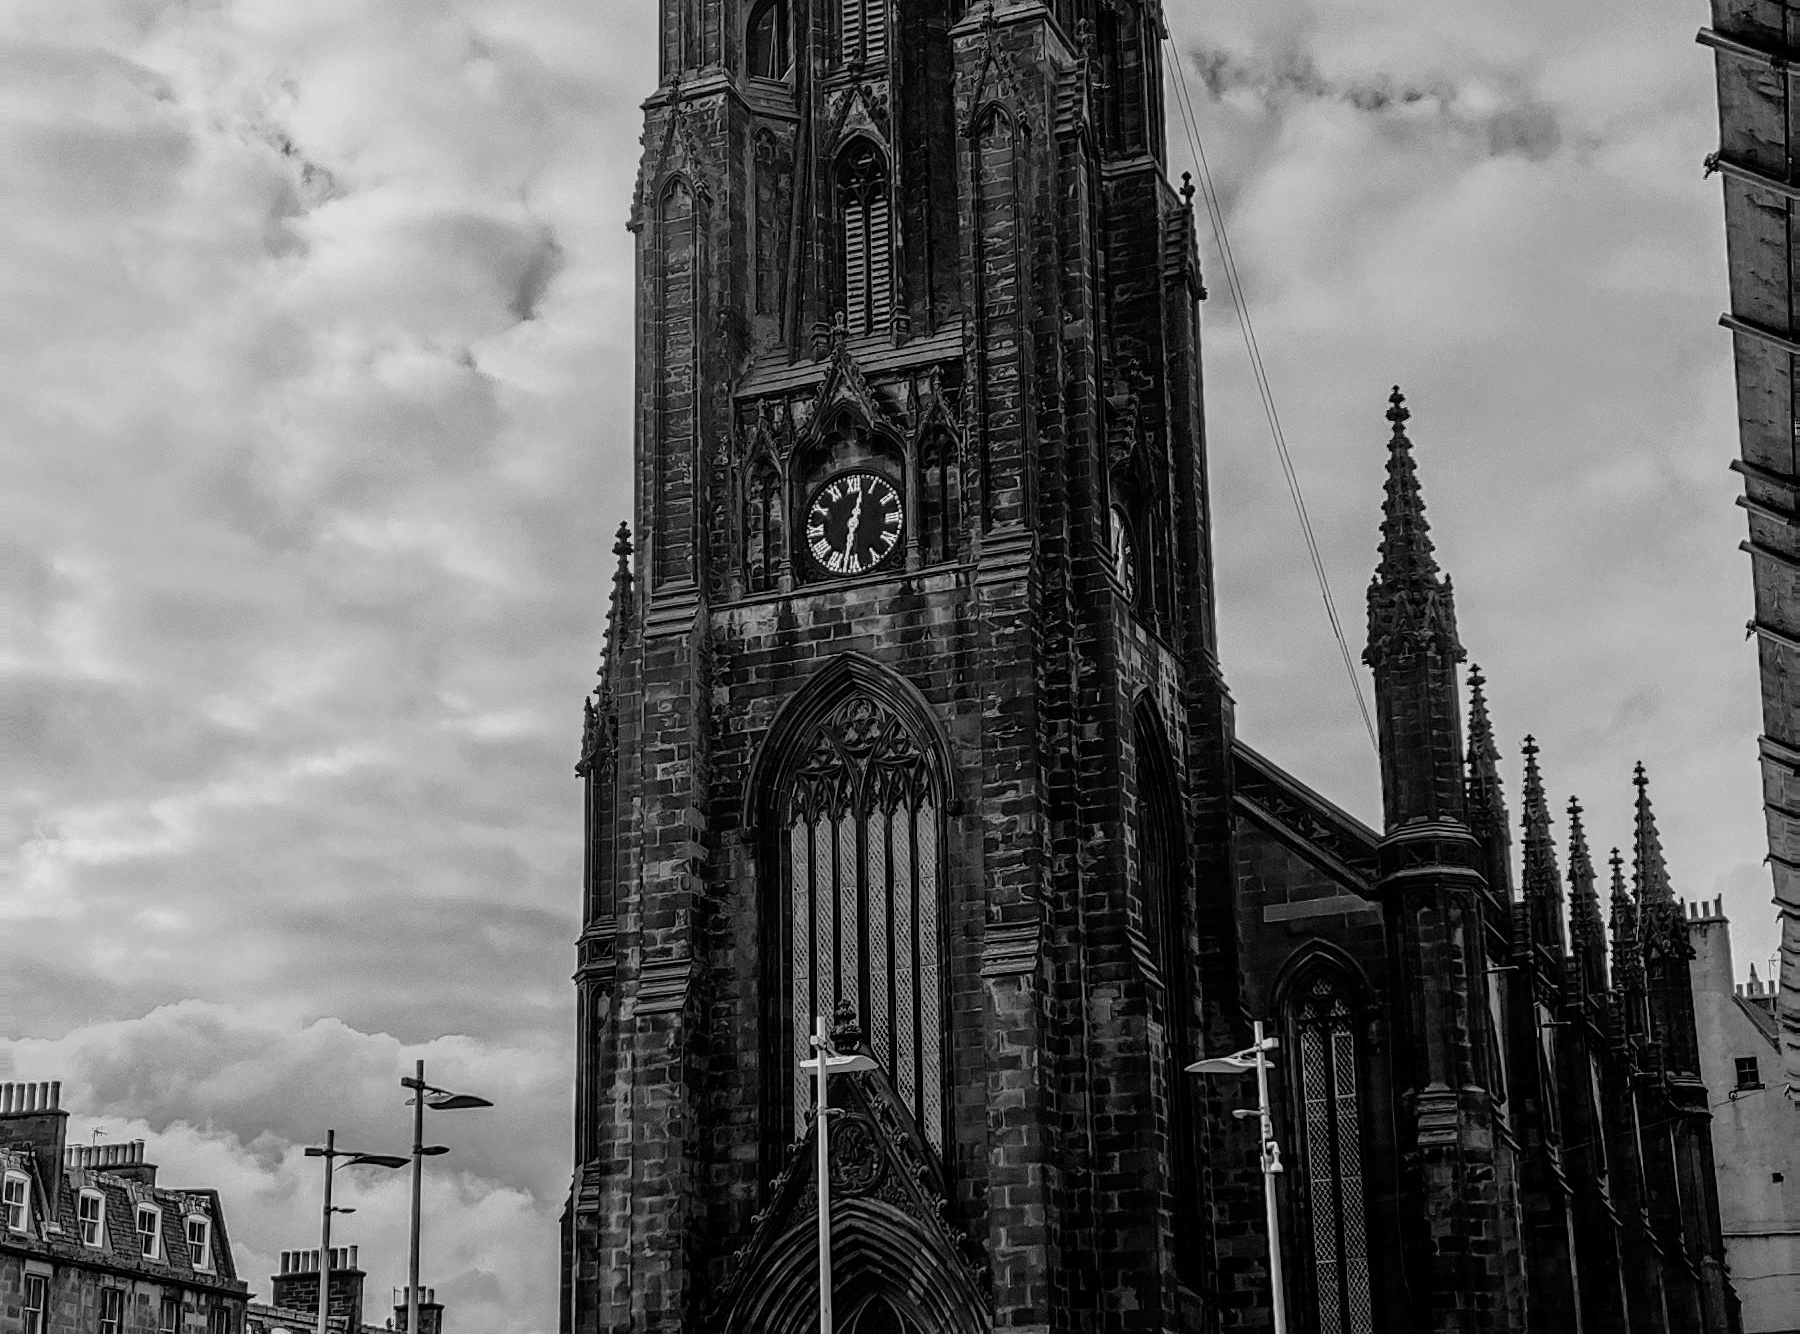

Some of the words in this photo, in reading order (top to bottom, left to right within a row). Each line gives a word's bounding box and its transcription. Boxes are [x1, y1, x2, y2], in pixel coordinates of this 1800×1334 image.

[847, 477, 861, 494] XII
[880, 492, 896, 506] II
[813, 504, 829, 516] X
[885, 512, 899, 524] III
[869, 547, 880, 563] V
